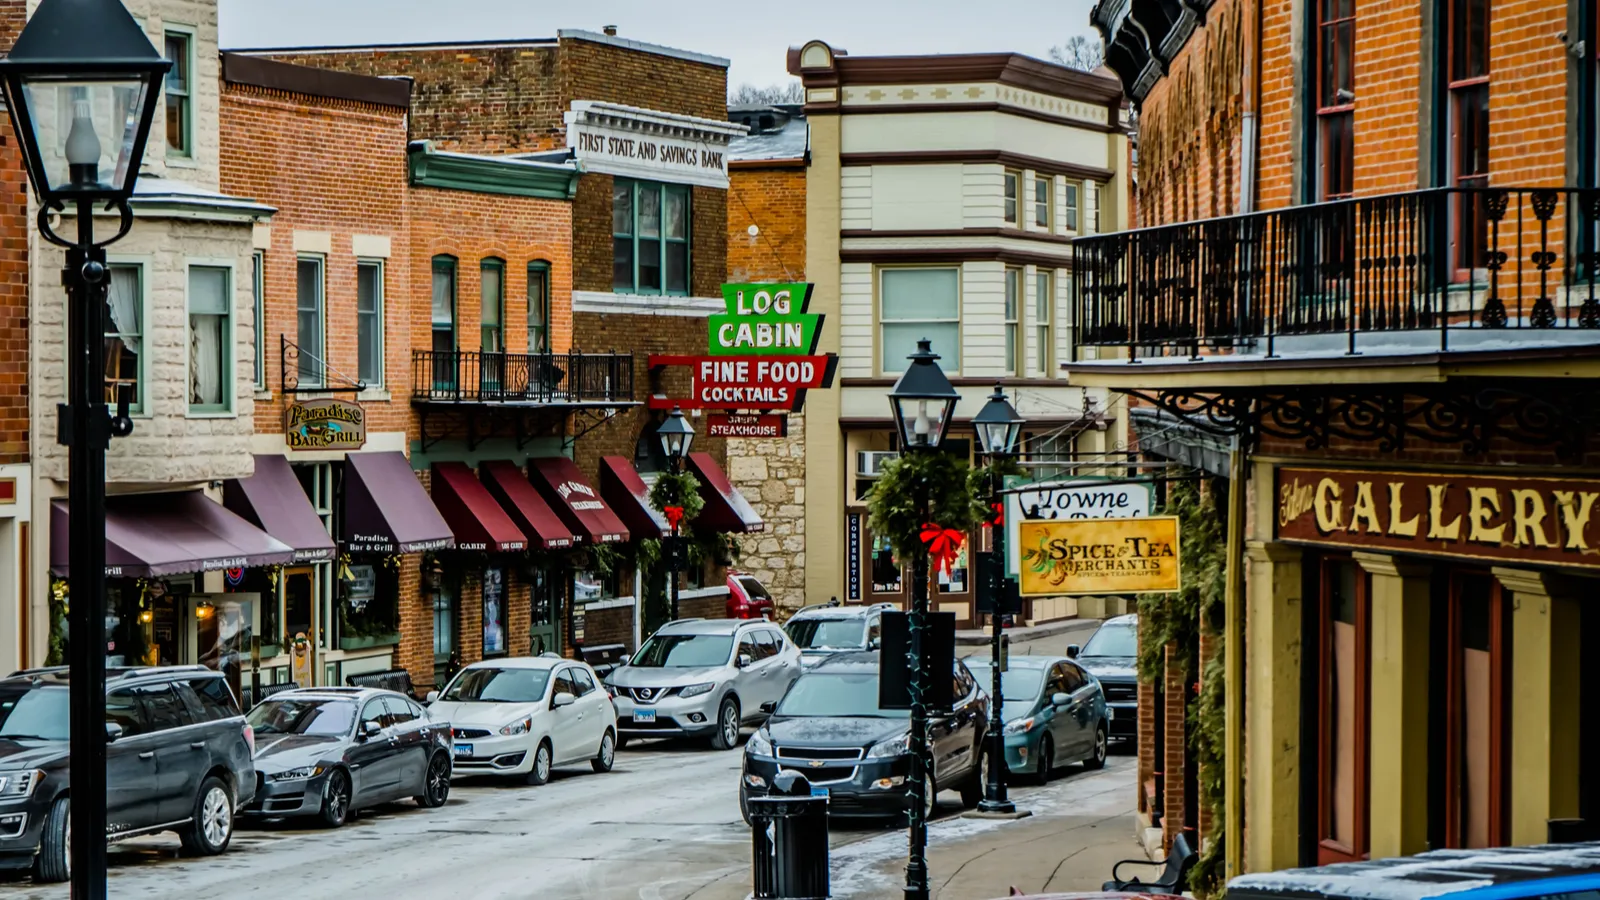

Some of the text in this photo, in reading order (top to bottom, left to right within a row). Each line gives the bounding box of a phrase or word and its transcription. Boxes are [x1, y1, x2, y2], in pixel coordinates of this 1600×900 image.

[579, 132, 724, 170] FIRST STATE AND SAVINGS BANK
[736, 290, 791, 315] LOG
[718, 323, 802, 348] CABIN
[701, 361, 815, 384] FINE FOOD
[701, 387, 789, 402] COCKTAILS
[290, 403, 362, 428] Paradise
[711, 425, 777, 436] STEAKHOUSE
[557, 481, 595, 499] LOG CABIN
[1314, 477, 1600, 550] GALLERY
[349, 543, 364, 551] Bar
[374, 543, 393, 551] Grill
[354, 534, 389, 542] Paradise
[460, 542, 487, 550] CABIN
[1049, 538, 1116, 561] SPICE
[1125, 537, 1174, 558] TEA
[1061, 559, 1160, 571] MERCHANTS
